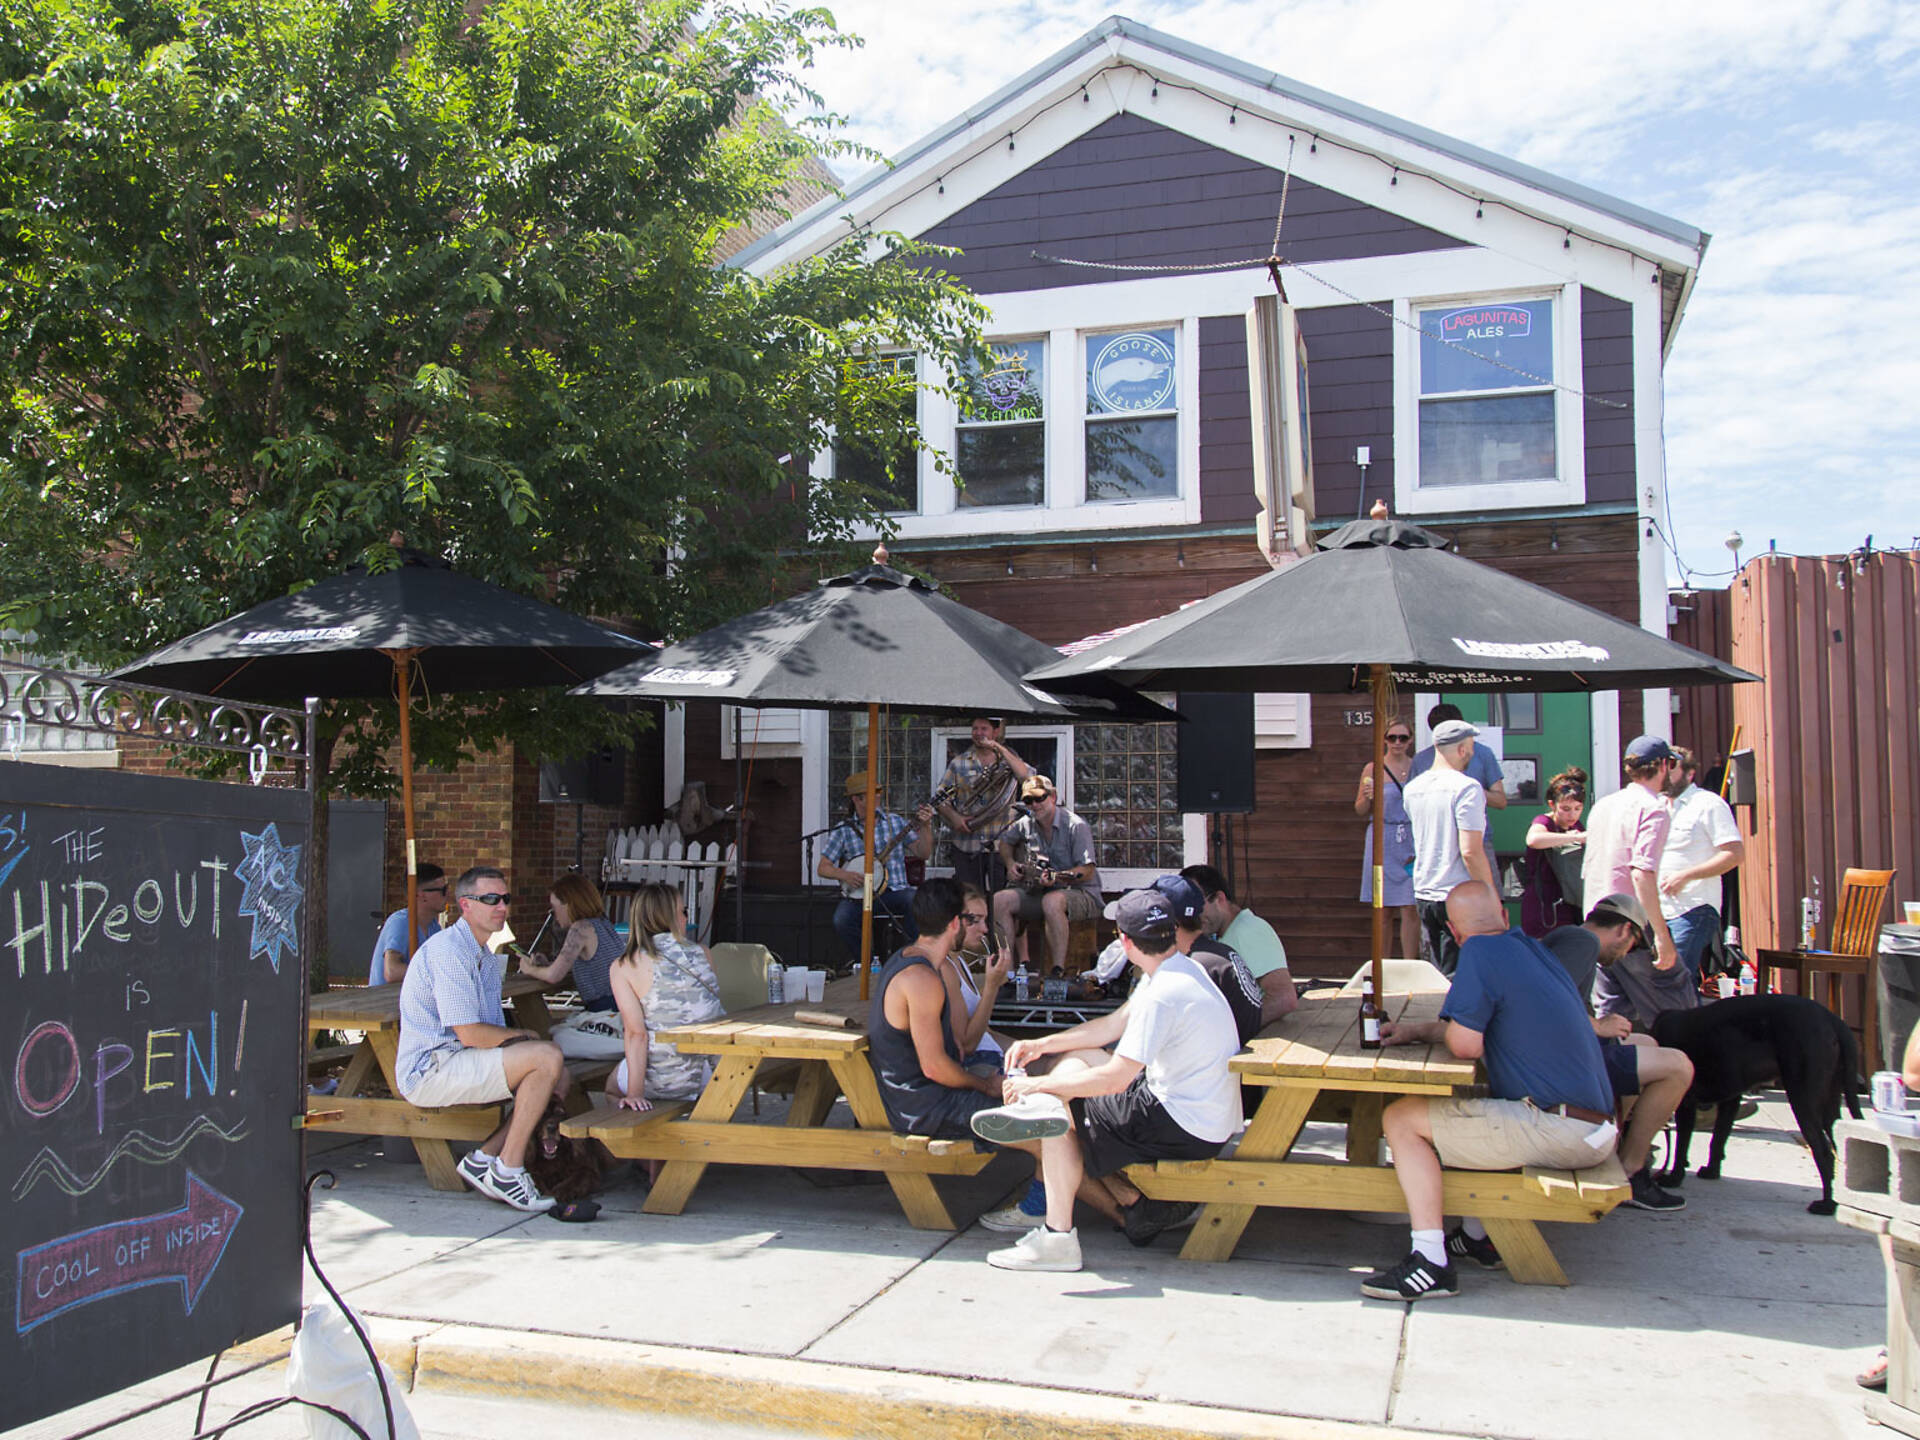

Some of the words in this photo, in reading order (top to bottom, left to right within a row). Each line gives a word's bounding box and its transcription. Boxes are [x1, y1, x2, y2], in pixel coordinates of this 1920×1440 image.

[1444, 311, 1528, 330] LAGUNITAS
[1466, 326, 1504, 339] ALES
[1110, 341, 1160, 359] GOOSE
[1109, 389, 1163, 411] ISLAND
[52, 827, 105, 864] THE
[257, 895, 289, 932] INSIDE
[16, 999, 248, 1135] OPEN!
[36, 1252, 101, 1299] COOL
[114, 1236, 151, 1266] OFF
[165, 1209, 229, 1252] INSIDE!
